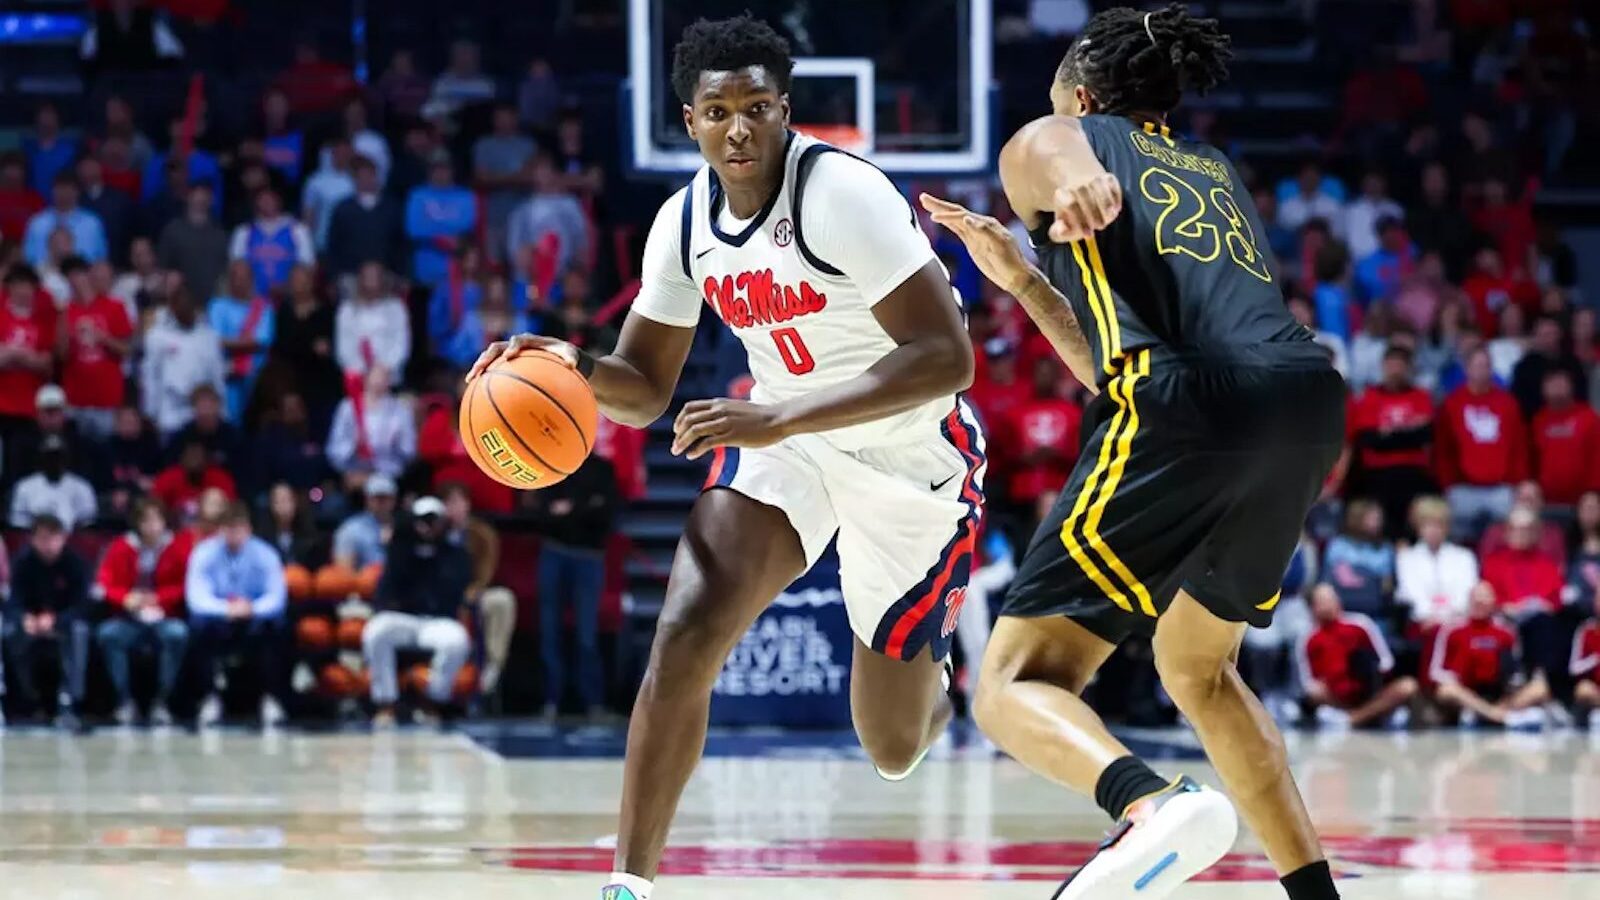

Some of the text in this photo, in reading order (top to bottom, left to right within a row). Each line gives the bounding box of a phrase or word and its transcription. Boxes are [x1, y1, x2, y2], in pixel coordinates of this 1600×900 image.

[703, 267, 827, 328] Ole Miss
[770, 327, 815, 375] 0
[479, 429, 538, 484] ELITE
